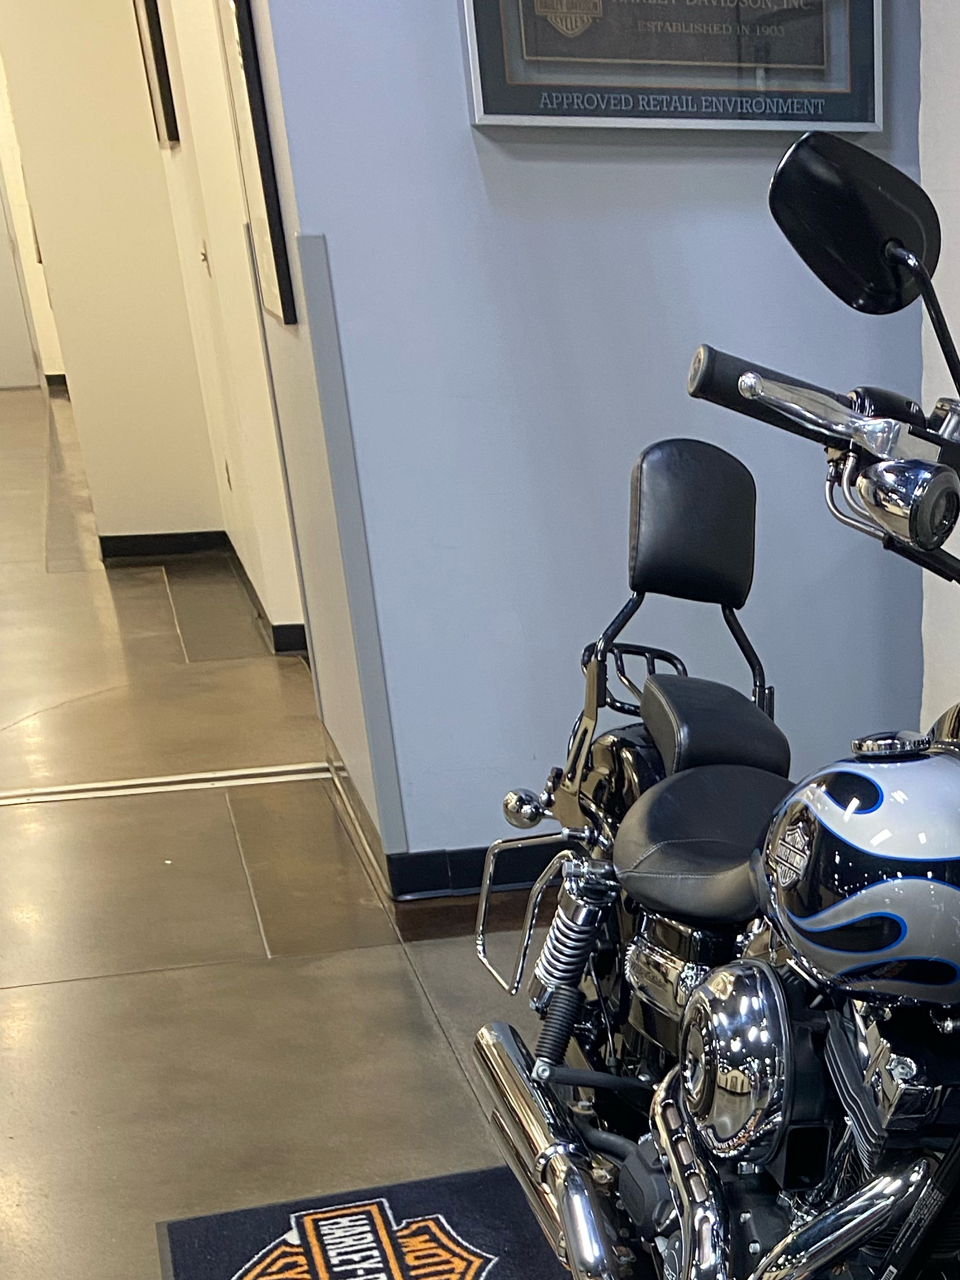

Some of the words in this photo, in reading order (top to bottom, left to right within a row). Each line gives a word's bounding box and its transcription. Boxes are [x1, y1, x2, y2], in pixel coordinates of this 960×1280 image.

[637, 20, 732, 35] ESTABLISHED
[736, 24, 750, 36] IN
[755, 25, 785, 37] 1903
[539, 92, 634, 110] APPROVED
[638, 95, 697, 112] RETAIL
[701, 97, 825, 115] ENVIRONMENT
